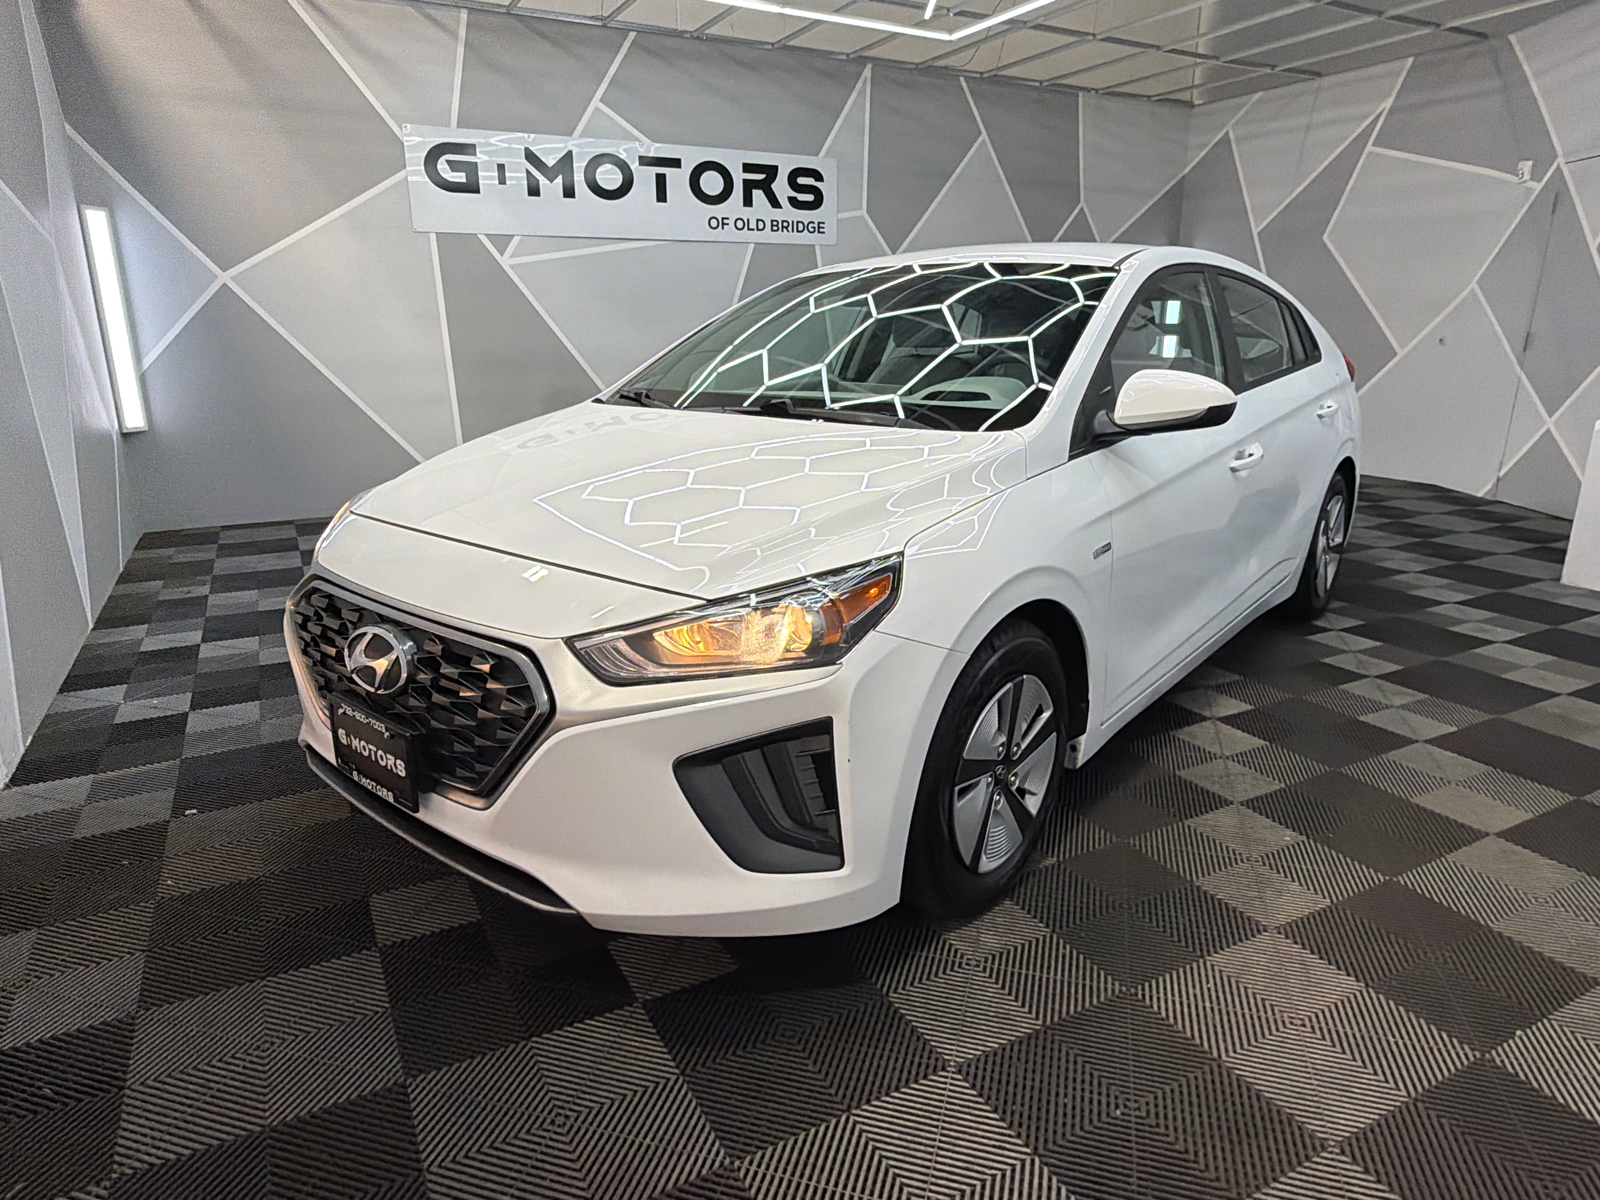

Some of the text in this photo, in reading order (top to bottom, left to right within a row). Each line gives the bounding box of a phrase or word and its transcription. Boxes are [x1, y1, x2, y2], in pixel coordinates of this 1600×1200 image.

[707, 216, 826, 235] OF OLD BRIDGE
